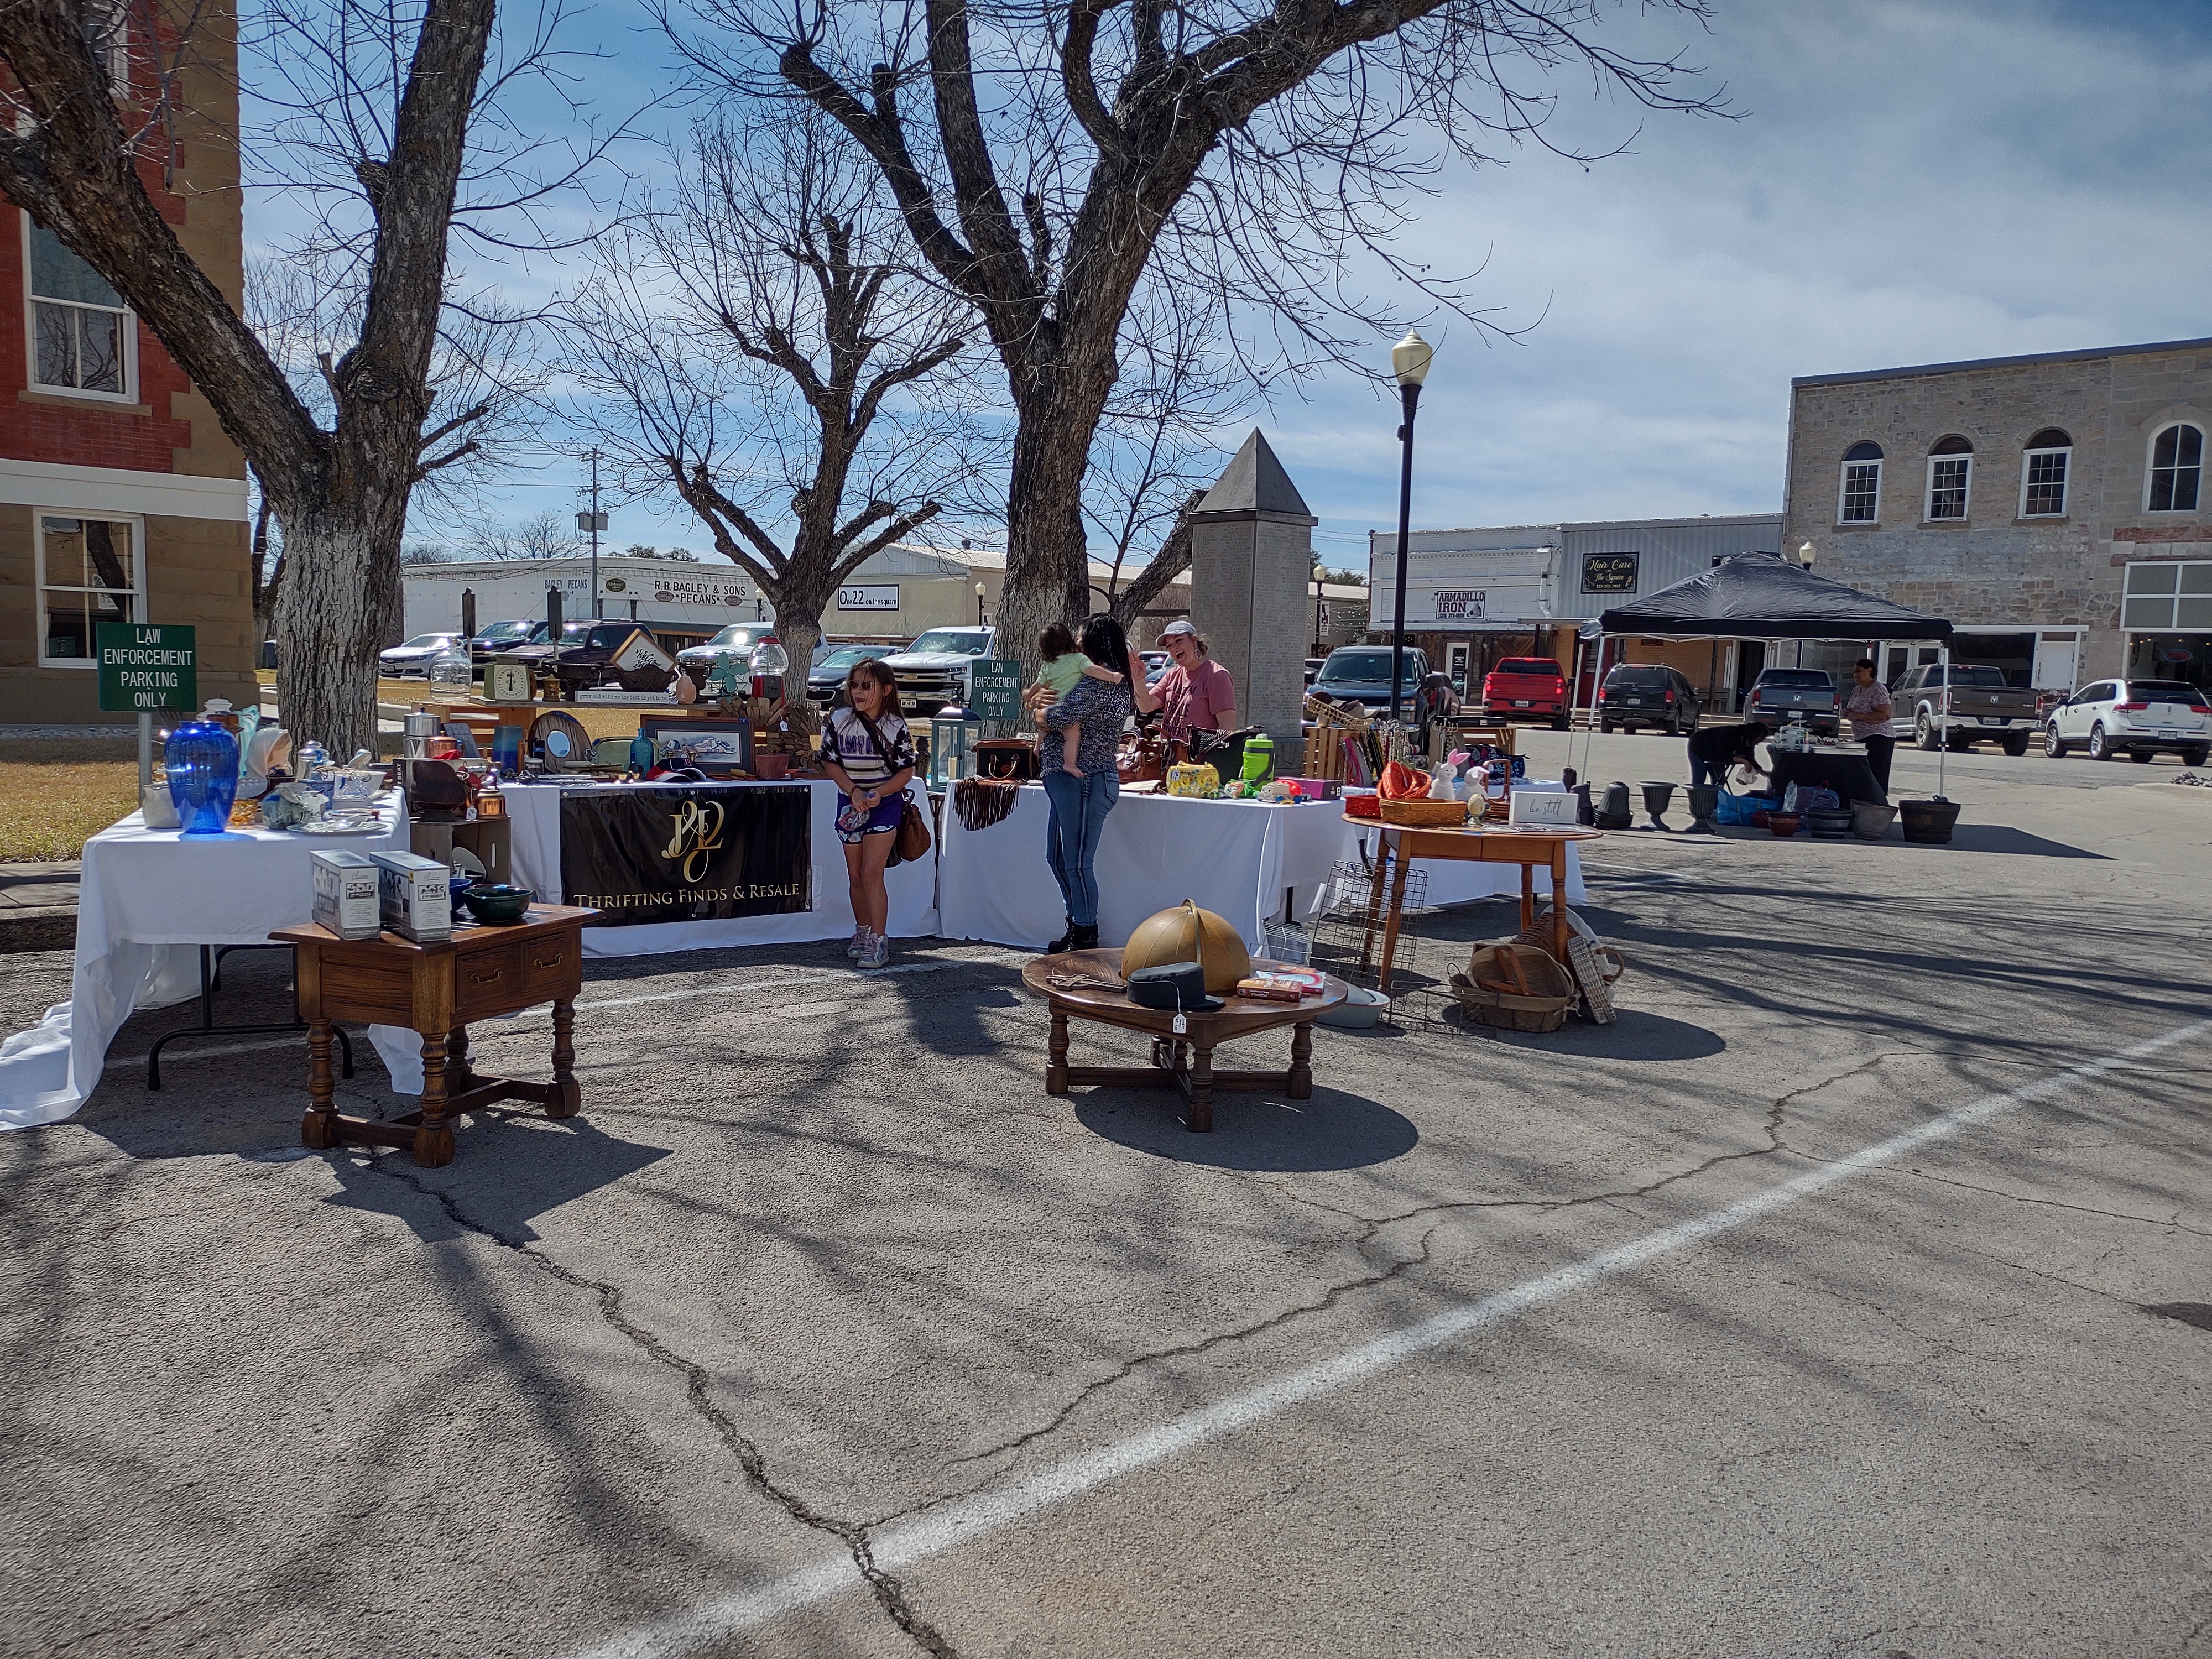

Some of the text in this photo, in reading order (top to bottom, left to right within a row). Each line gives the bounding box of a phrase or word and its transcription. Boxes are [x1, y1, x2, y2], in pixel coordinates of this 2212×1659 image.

[1587, 559, 1632, 571] Hair Care
[1605, 573, 1624, 583] Square
[568, 580, 587, 589] PECANS
[673, 582, 709, 593] BAGLEY
[713, 585, 719, 594] &
[724, 586, 746, 596] SONS
[680, 593, 716, 604] PECANS
[1439, 592, 1484, 602] ARMADILLO
[1438, 602, 1467, 612] IRON
[136, 628, 161, 643] LAW
[104, 649, 193, 665] ENFORCEMENT
[991, 662, 1004, 673] LAW
[121, 671, 178, 687] PARKING
[975, 677, 1018, 688] ENFORCEMENT
[134, 692, 166, 707] ONLY
[982, 692, 1010, 703] PARKING
[988, 706, 1004, 716] ONLY
[839, 734, 865, 754] LADY
[1530, 798, 1562, 818] be still
[573, 883, 800, 909] THRIFTING FINDS & RESALE
